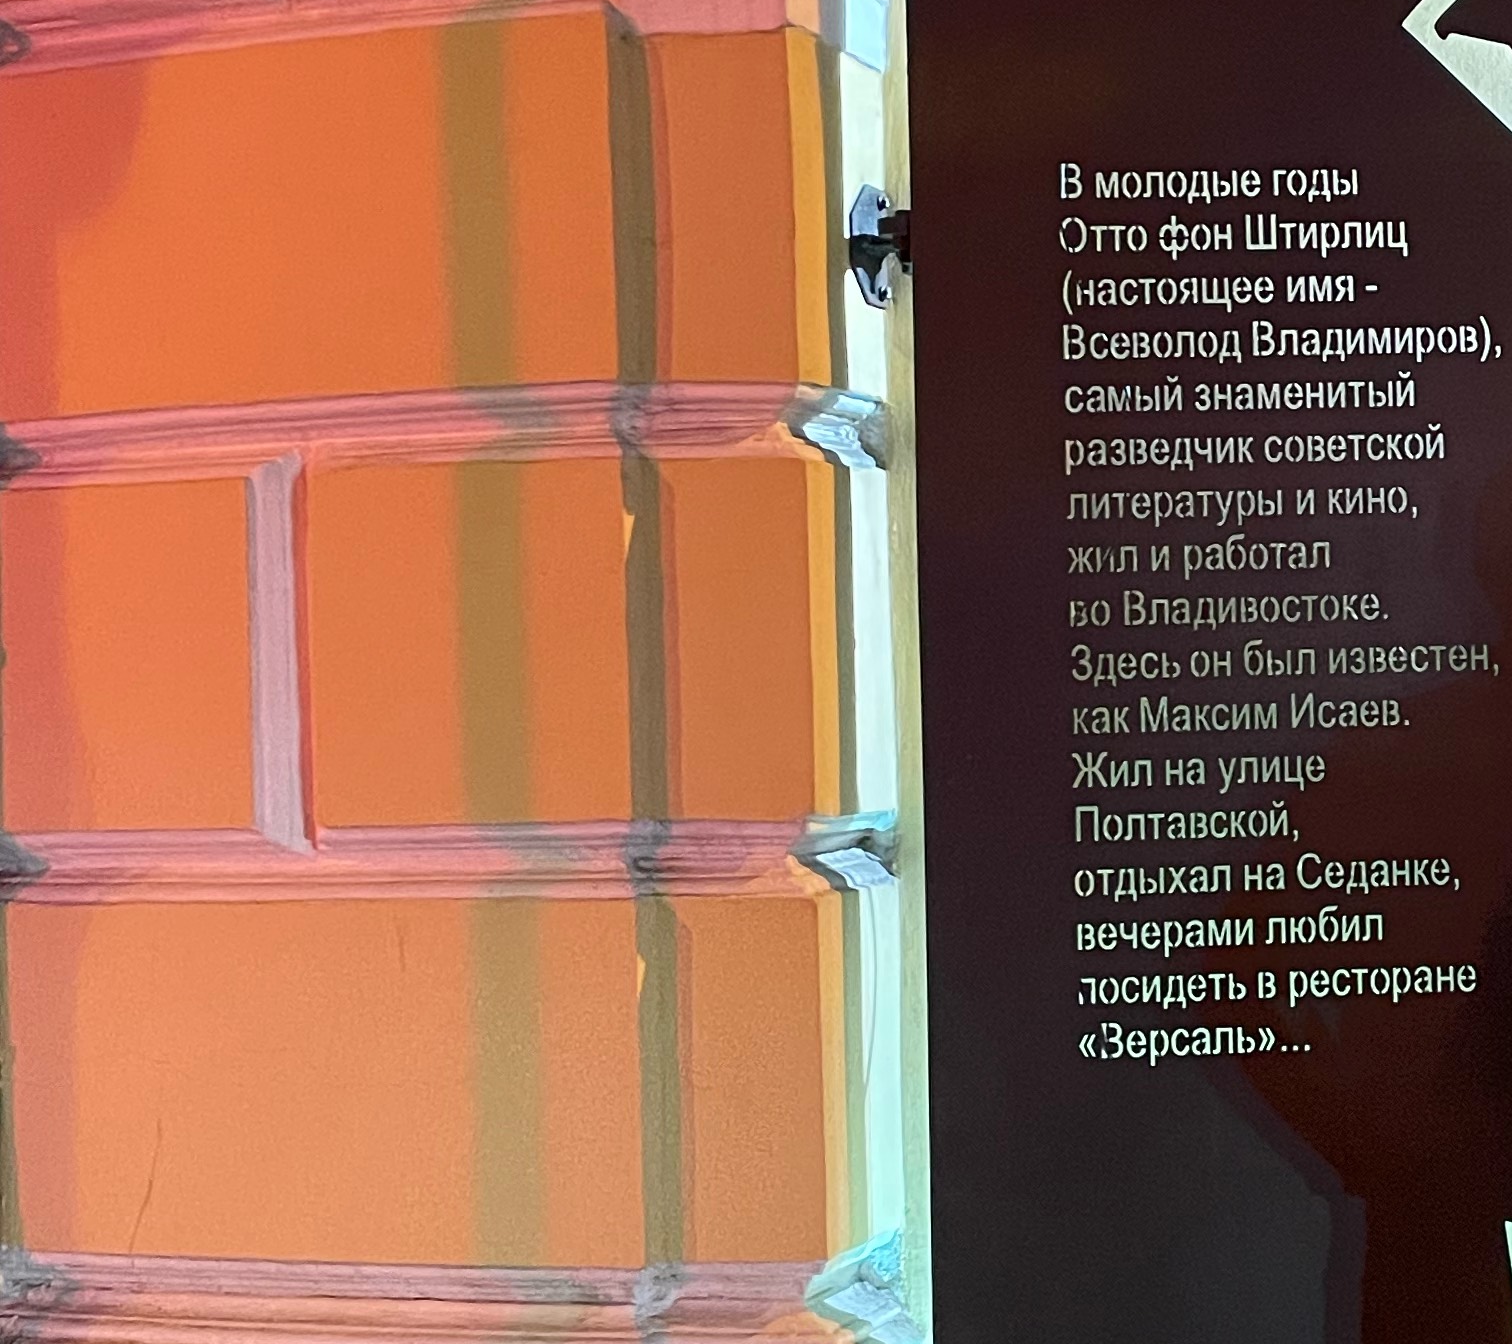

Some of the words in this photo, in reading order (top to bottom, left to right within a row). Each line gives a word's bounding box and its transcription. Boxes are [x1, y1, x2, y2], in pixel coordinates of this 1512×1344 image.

[1060, 162, 1083, 199] В
[1095, 169, 1261, 205] молодые
[1272, 168, 1359, 203] годы
[1058, 216, 1148, 254] Отто
[1158, 215, 1233, 261] фон
[1245, 213, 1409, 259] Штирлиц
[1062, 269, 1275, 316] (настоящее
[1286, 274, 1355, 303] имя
[1062, 323, 1242, 364] Всеволод
[1252, 315, 1502, 363] Владимиров),
[1064, 375, 1183, 414] самый
[1194, 370, 1415, 412] знаменитый
[1064, 436, 1254, 476] разведчик
[1264, 423, 1445, 463] советской
[1066, 489, 1283, 528] литературы
[1296, 488, 1315, 515] и
[1327, 486, 1418, 519] кино,
[1067, 545, 1138, 574] жил
[1150, 545, 1170, 572] и
[1183, 533, 1331, 581] работал
[1069, 600, 1111, 628] во
[1123, 590, 1389, 631] Владивостоке.
[1070, 644, 1181, 688] Здесь
[1190, 650, 1232, 678] он
[1243, 639, 1316, 676] был
[1328, 644, 1499, 676] известен,
[1072, 706, 1130, 735] как
[1139, 695, 1278, 733] Максим
[1290, 692, 1410, 729] Исаев.
[1071, 751, 1153, 789] Жил
[1165, 757, 1206, 786] на
[1217, 755, 1326, 795] улице
[1075, 800, 1299, 843] Полтавской,
[1074, 864, 1231, 903] отдыхал
[1243, 863, 1286, 892] на
[1296, 852, 1460, 895] Седанке,
[1076, 918, 1254, 958] вечерами
[1265, 905, 1383, 945] любил
[1078, 972, 1247, 1010] посидеть
[1257, 971, 1277, 999] в
[1289, 965, 1477, 1008] ресторане
